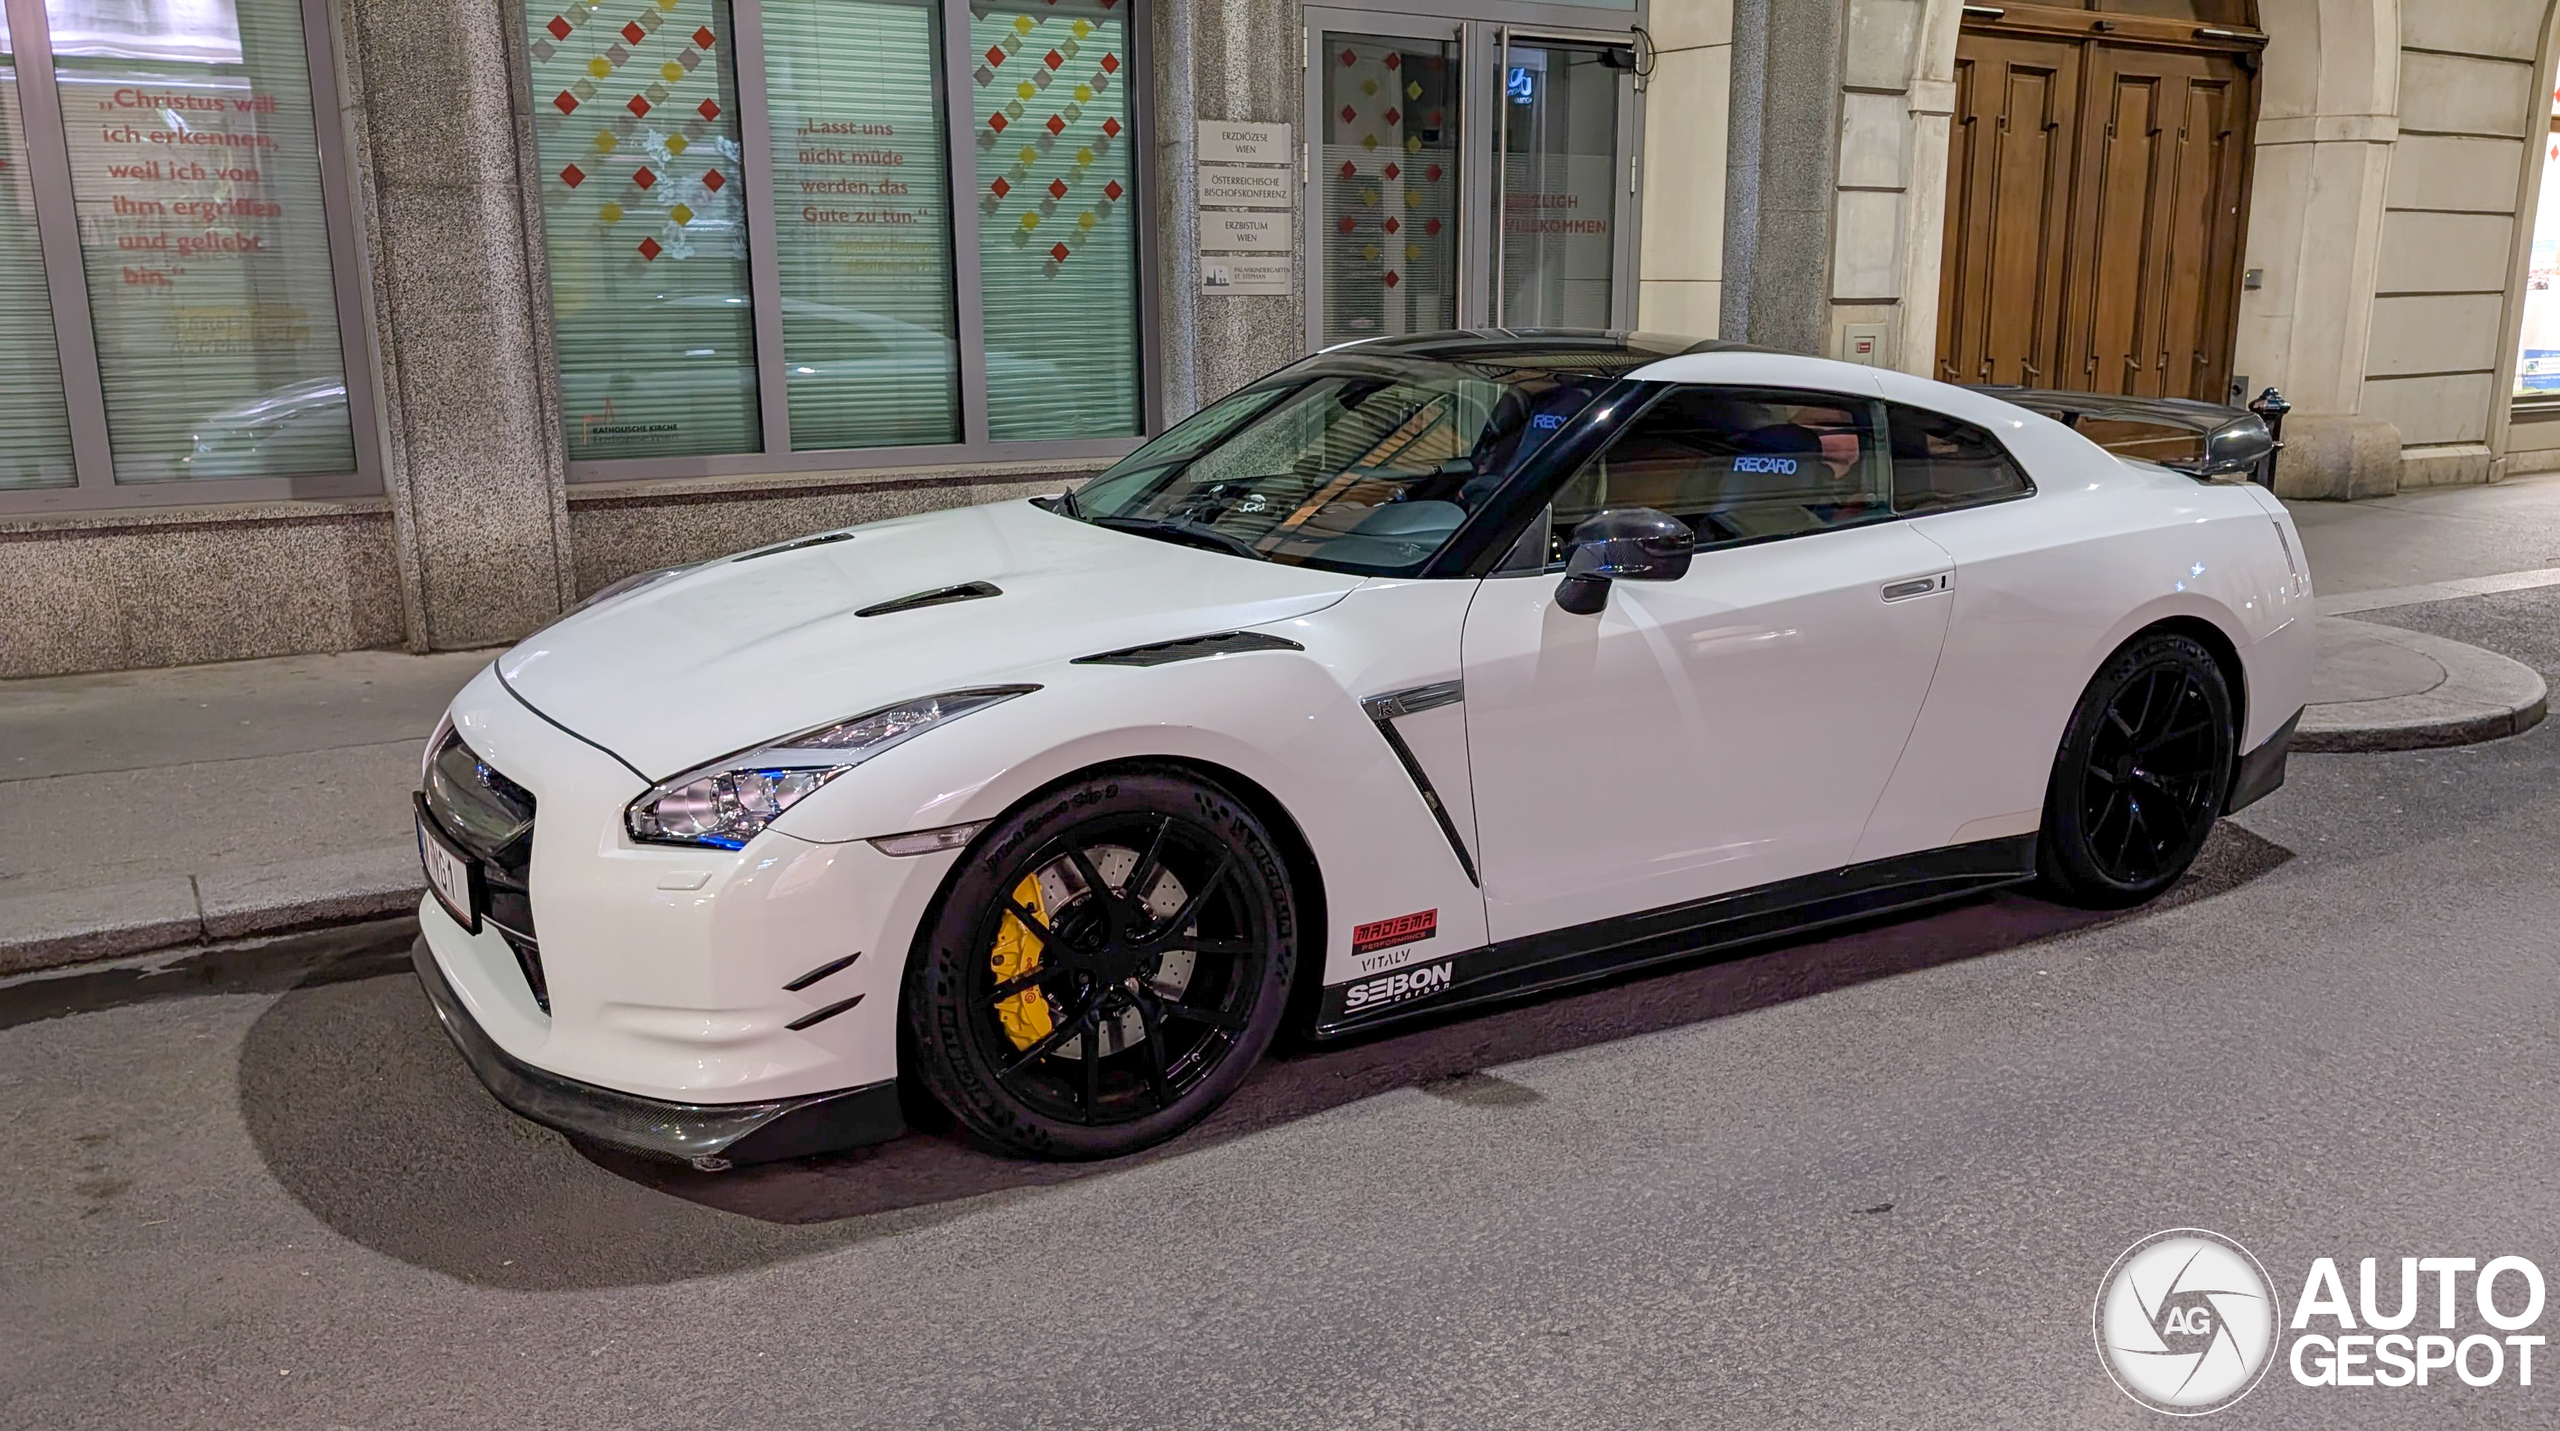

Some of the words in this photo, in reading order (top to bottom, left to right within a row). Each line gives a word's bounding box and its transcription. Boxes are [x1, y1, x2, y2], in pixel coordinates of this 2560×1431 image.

[797, 117, 857, 136] „Lasst
[862, 124, 894, 136] uns
[102, 123, 141, 143] ich
[150, 126, 279, 150] erkennen,
[1221, 131, 1268, 143] ERZDIÖZESE
[798, 146, 846, 165] nicht
[852, 149, 905, 166] müde
[1235, 145, 1256, 154] WIEN
[107, 160, 160, 180] weil
[168, 160, 206, 180] ich
[215, 168, 260, 182] von
[1211, 174, 1280, 187] ÖSTERREICHISCHE
[801, 177, 875, 196] werden,
[879, 178, 909, 195] das
[1204, 188, 1287, 200] BISCHOFSKONFERENZ
[112, 195, 166, 216] ihm
[802, 206, 850, 224] Gute
[855, 210, 877, 224] zu
[1225, 221, 1268, 231] ERZBISTUM
[118, 230, 168, 250] und
[177, 231, 264, 257] geliebt
[1236, 234, 1258, 243] WIEN
[592, 424, 647, 434] KATHOLISCHE
[649, 423, 678, 432] KIRCHE
[1733, 457, 1797, 475] RECARO
[1362, 931, 1426, 950] PERFORMANCE
[1362, 949, 1411, 972] VITALY
[1346, 962, 1453, 1006] SEIBON
[1395, 982, 1450, 1002] carbon
